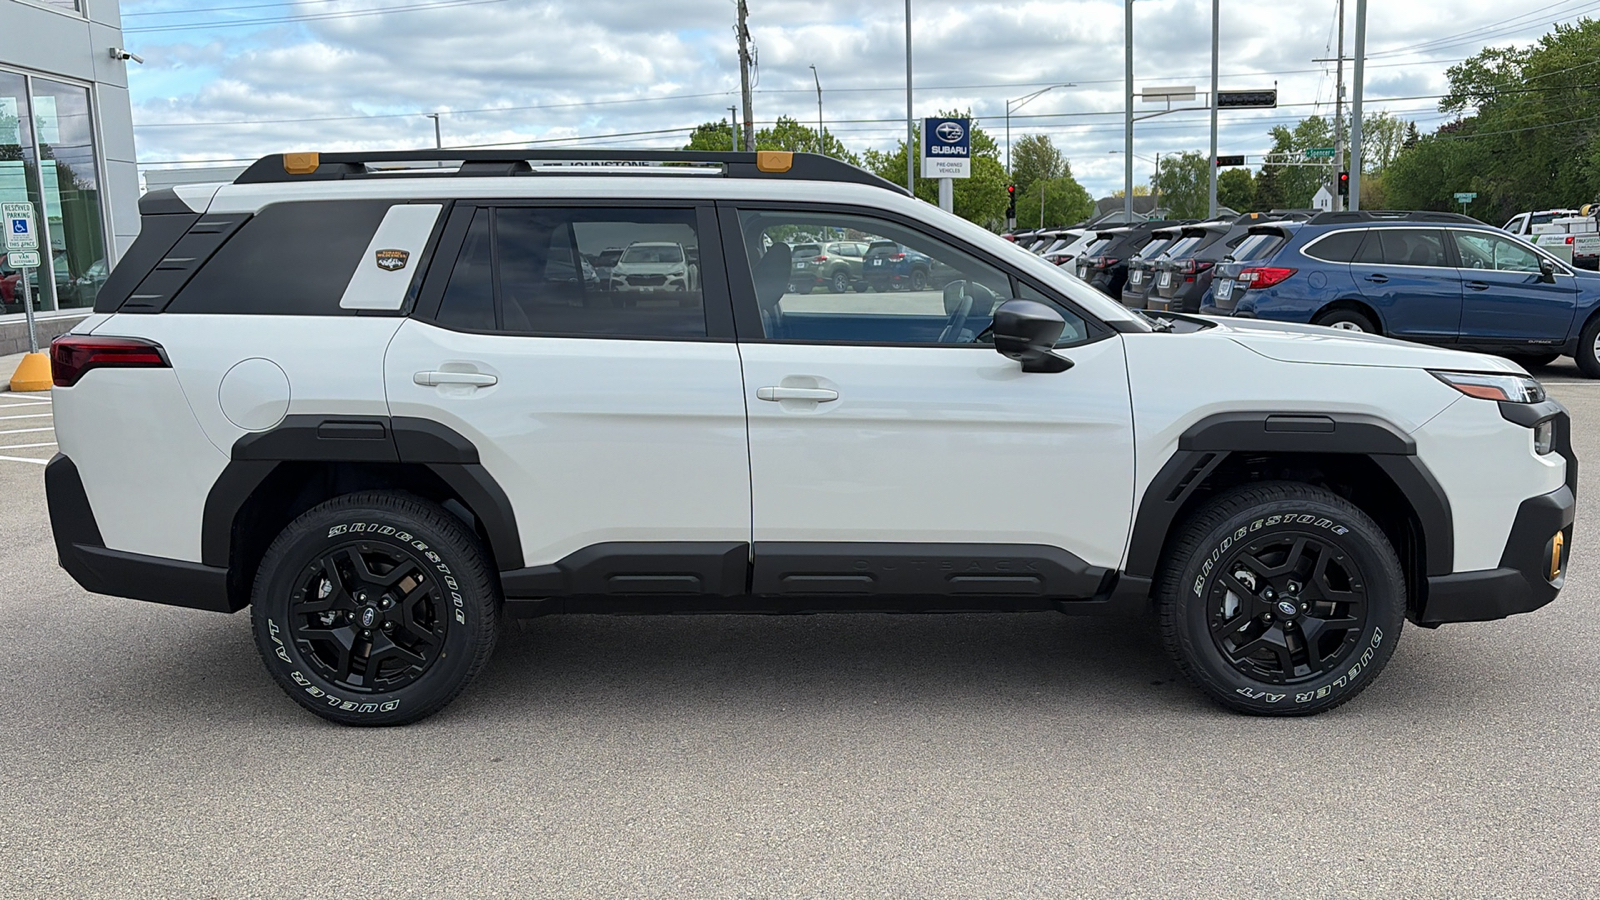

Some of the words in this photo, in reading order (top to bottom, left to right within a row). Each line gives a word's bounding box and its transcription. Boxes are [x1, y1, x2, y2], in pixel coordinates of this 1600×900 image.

[931, 145, 967, 154] SUBARU
[1310, 149, 1331, 157] Spencer
[4, 204, 31, 212] RESERVED
[852, 560, 1038, 571] OUTBACK
[1193, 513, 1350, 598] BRIDGESTONE
[327, 522, 465, 625] BRIDGESTONE
[268, 618, 292, 663] A/T
[1295, 626, 1384, 703] DUELER
[290, 670, 400, 713] DUELER
[1236, 686, 1286, 703] A/T
